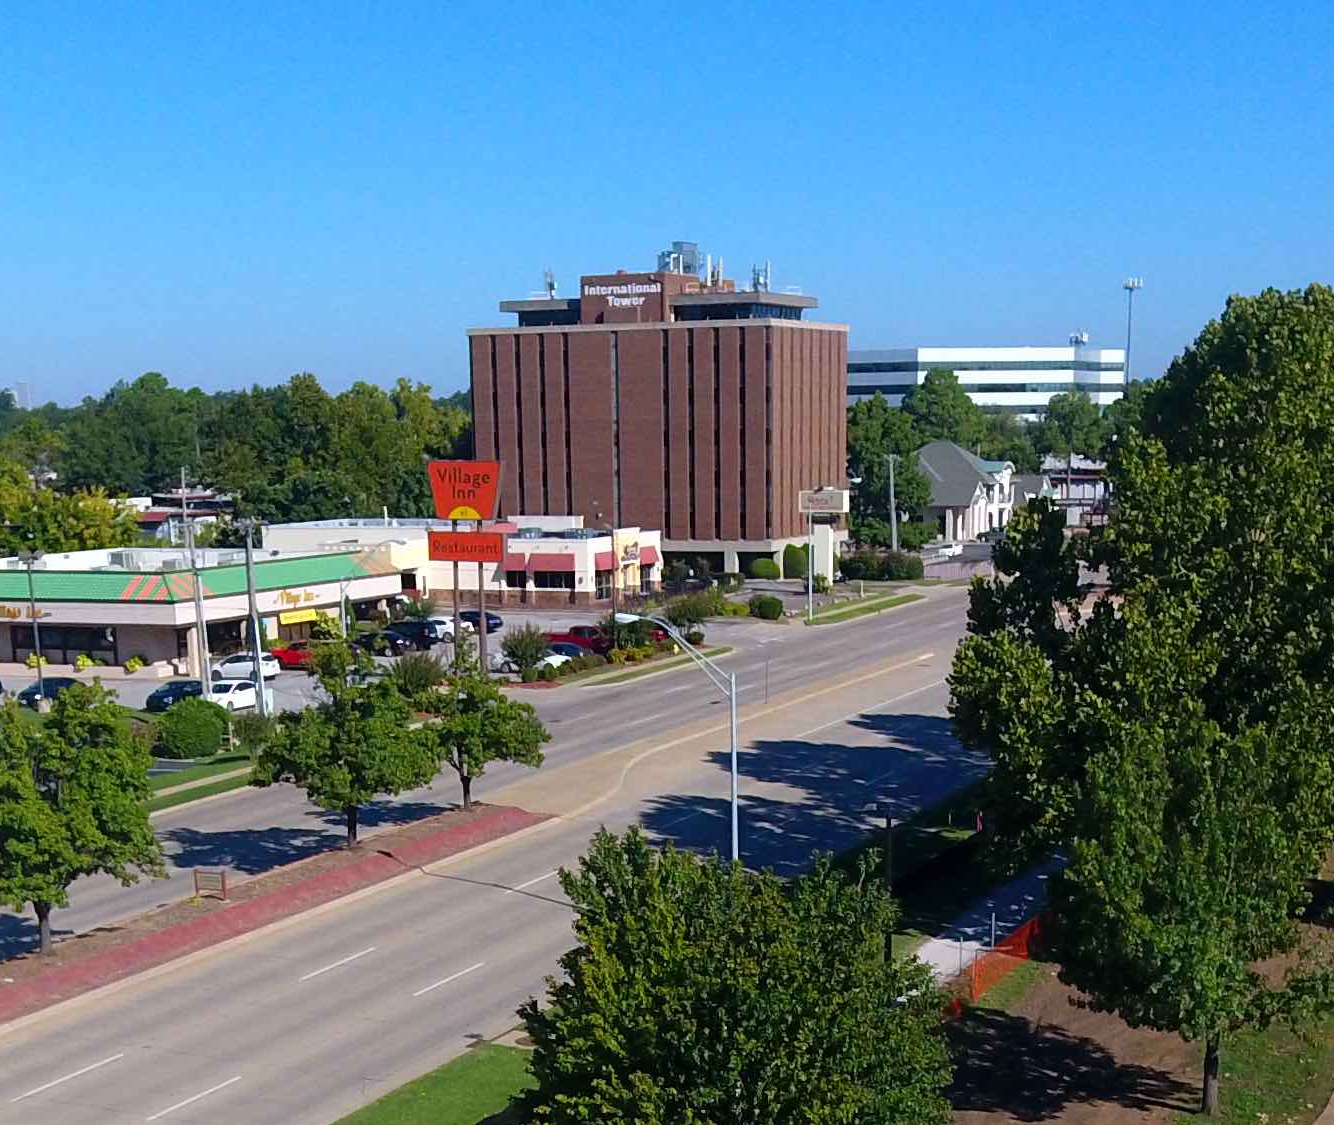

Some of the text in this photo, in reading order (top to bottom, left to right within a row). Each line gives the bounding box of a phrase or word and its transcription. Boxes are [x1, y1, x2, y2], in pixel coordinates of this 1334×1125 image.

[584, 283, 661, 295] International
[606, 296, 645, 307] Tower
[437, 466, 491, 488] Village
[452, 486, 476, 499] Inn
[433, 540, 499, 555] Restaurant
